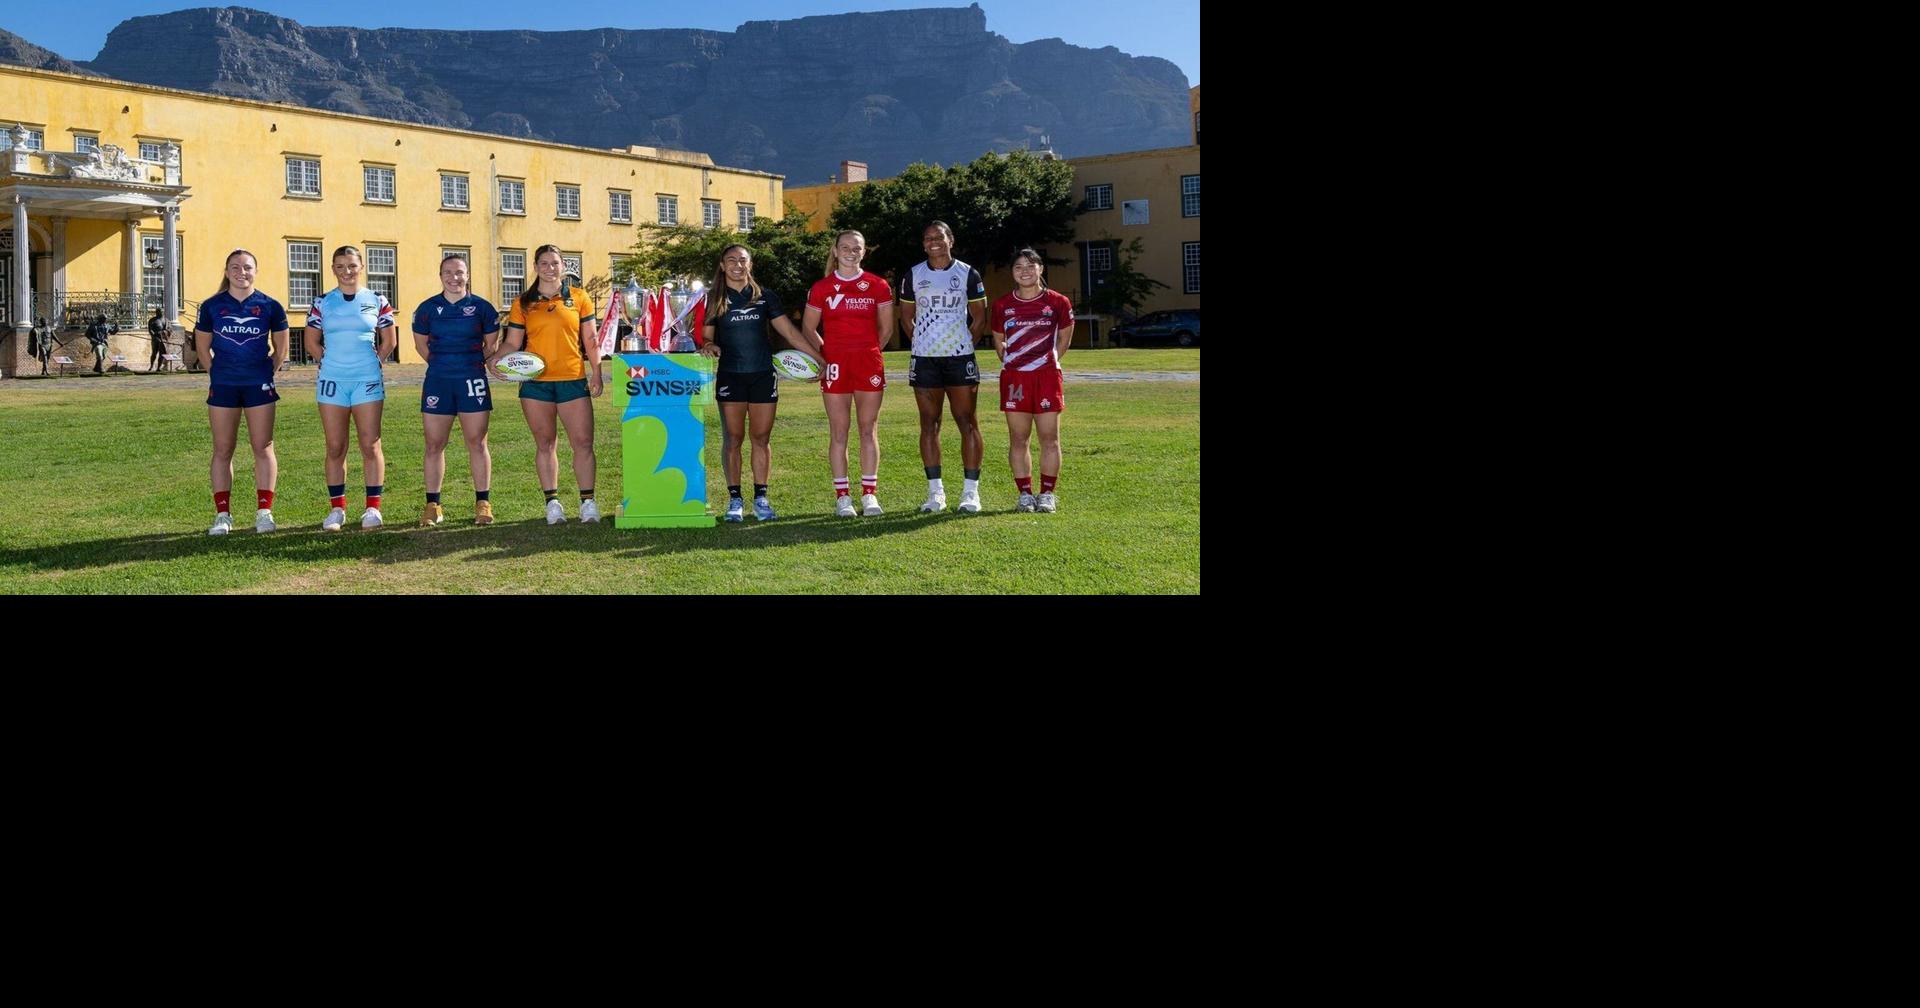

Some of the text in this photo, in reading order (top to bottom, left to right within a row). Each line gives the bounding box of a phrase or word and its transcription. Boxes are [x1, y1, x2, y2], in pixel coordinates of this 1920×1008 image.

[730, 314, 760, 322] ALTRAD
[220, 325, 260, 335] ALTRAD
[650, 368, 671, 376] HSBC
[826, 363, 839, 380] 19
[319, 380, 336, 398] 10
[466, 379, 486, 397] 12
[626, 380, 685, 396] SVNS
[1008, 384, 1024, 401] 14
